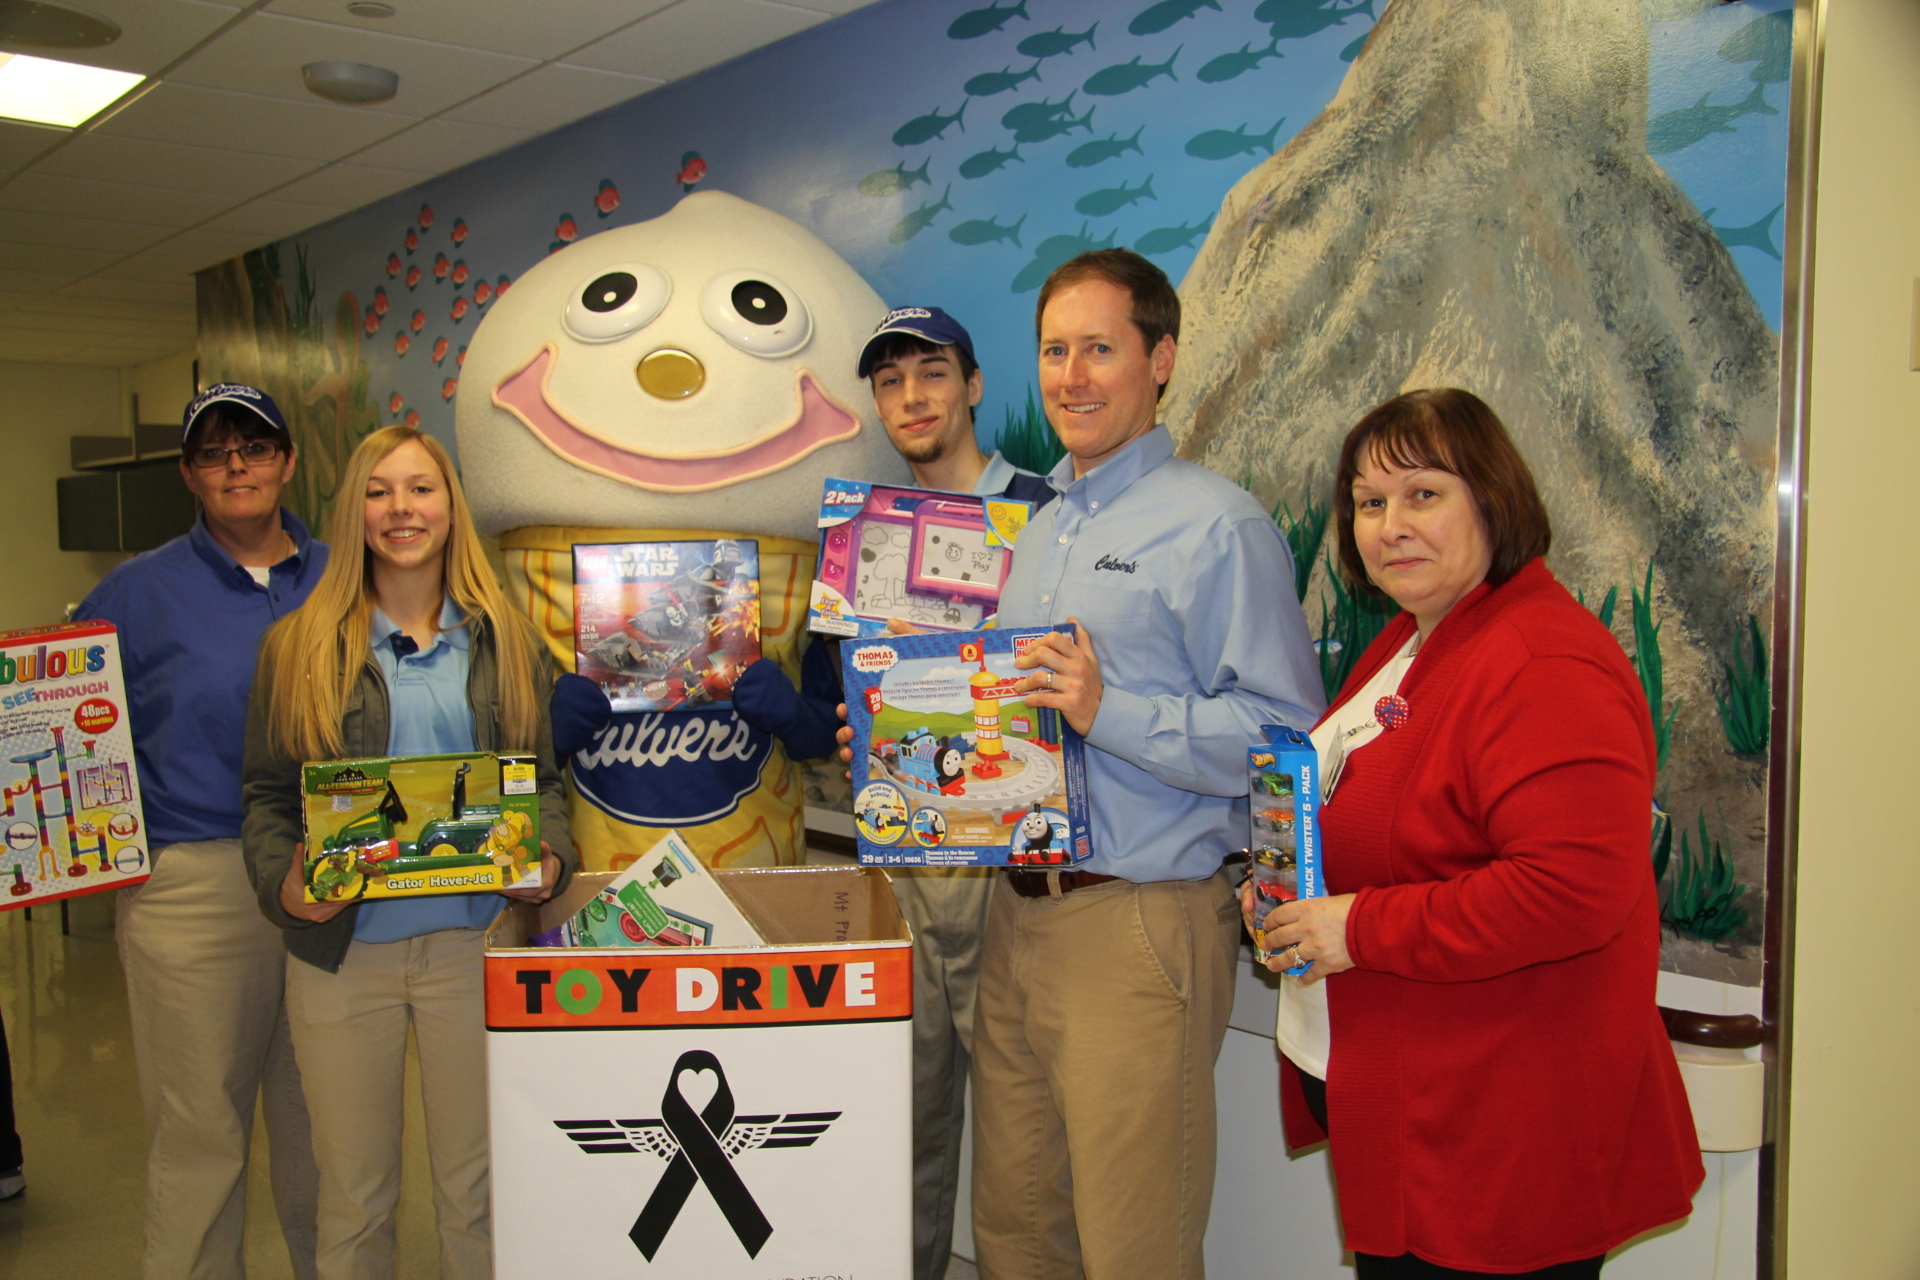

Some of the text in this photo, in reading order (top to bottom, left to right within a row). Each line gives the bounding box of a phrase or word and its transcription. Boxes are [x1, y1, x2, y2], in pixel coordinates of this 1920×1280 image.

[824, 490, 866, 504] 2 Pack
[614, 546, 679, 562] STAR
[988, 553, 993, 561] 2
[582, 556, 607, 570] LEGO
[617, 562, 680, 577] WARS
[972, 560, 990, 572] Play
[580, 593, 605, 604] 7-12
[857, 589, 864, 598] A
[581, 625, 596, 633] 214
[857, 651, 894, 660] THOMAS
[1, 681, 109, 710] SEE THROUGH
[870, 692, 881, 703] 29
[82, 704, 110, 718] 48pcs
[317, 780, 362, 791] ALL-TERRAIN
[362, 778, 384, 788] TEAM
[1302, 765, 1311, 794] PACK
[1303, 803, 1311, 811] 5
[1303, 815, 1313, 864] TWISTER
[862, 854, 874, 864] 29
[387, 872, 493, 891] Gator Hover-Jet
[1305, 867, 1314, 899] TRACK
[516, 961, 876, 1015] TOY DRIVE
